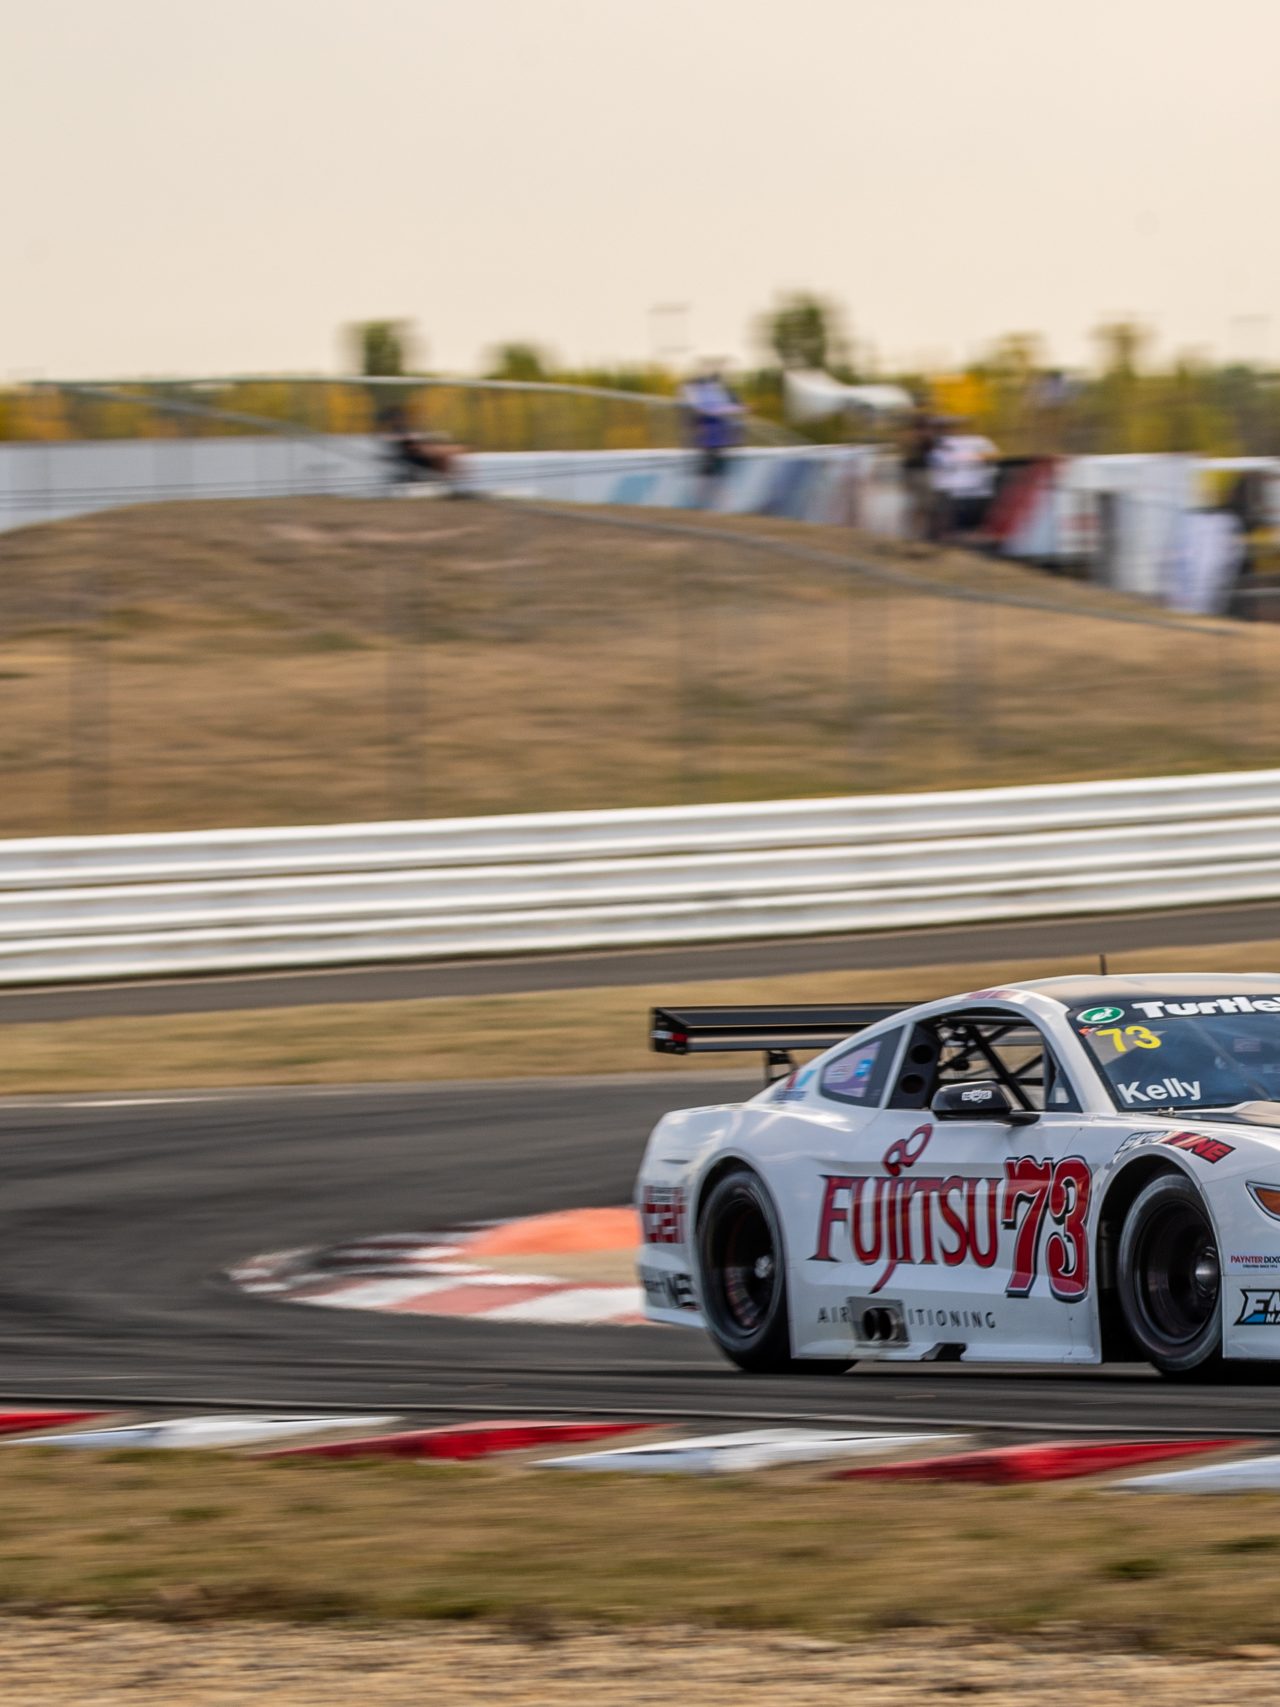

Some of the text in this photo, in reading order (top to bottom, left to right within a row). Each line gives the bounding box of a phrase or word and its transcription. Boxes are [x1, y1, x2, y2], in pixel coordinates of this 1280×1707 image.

[1095, 1025, 1162, 1053] 73
[1117, 1077, 1201, 1104] Kelly
[807, 1174, 1002, 1295] FUJITSU
[1001, 1154, 1093, 1304] 73
[907, 1308, 996, 1329] ITIONING
